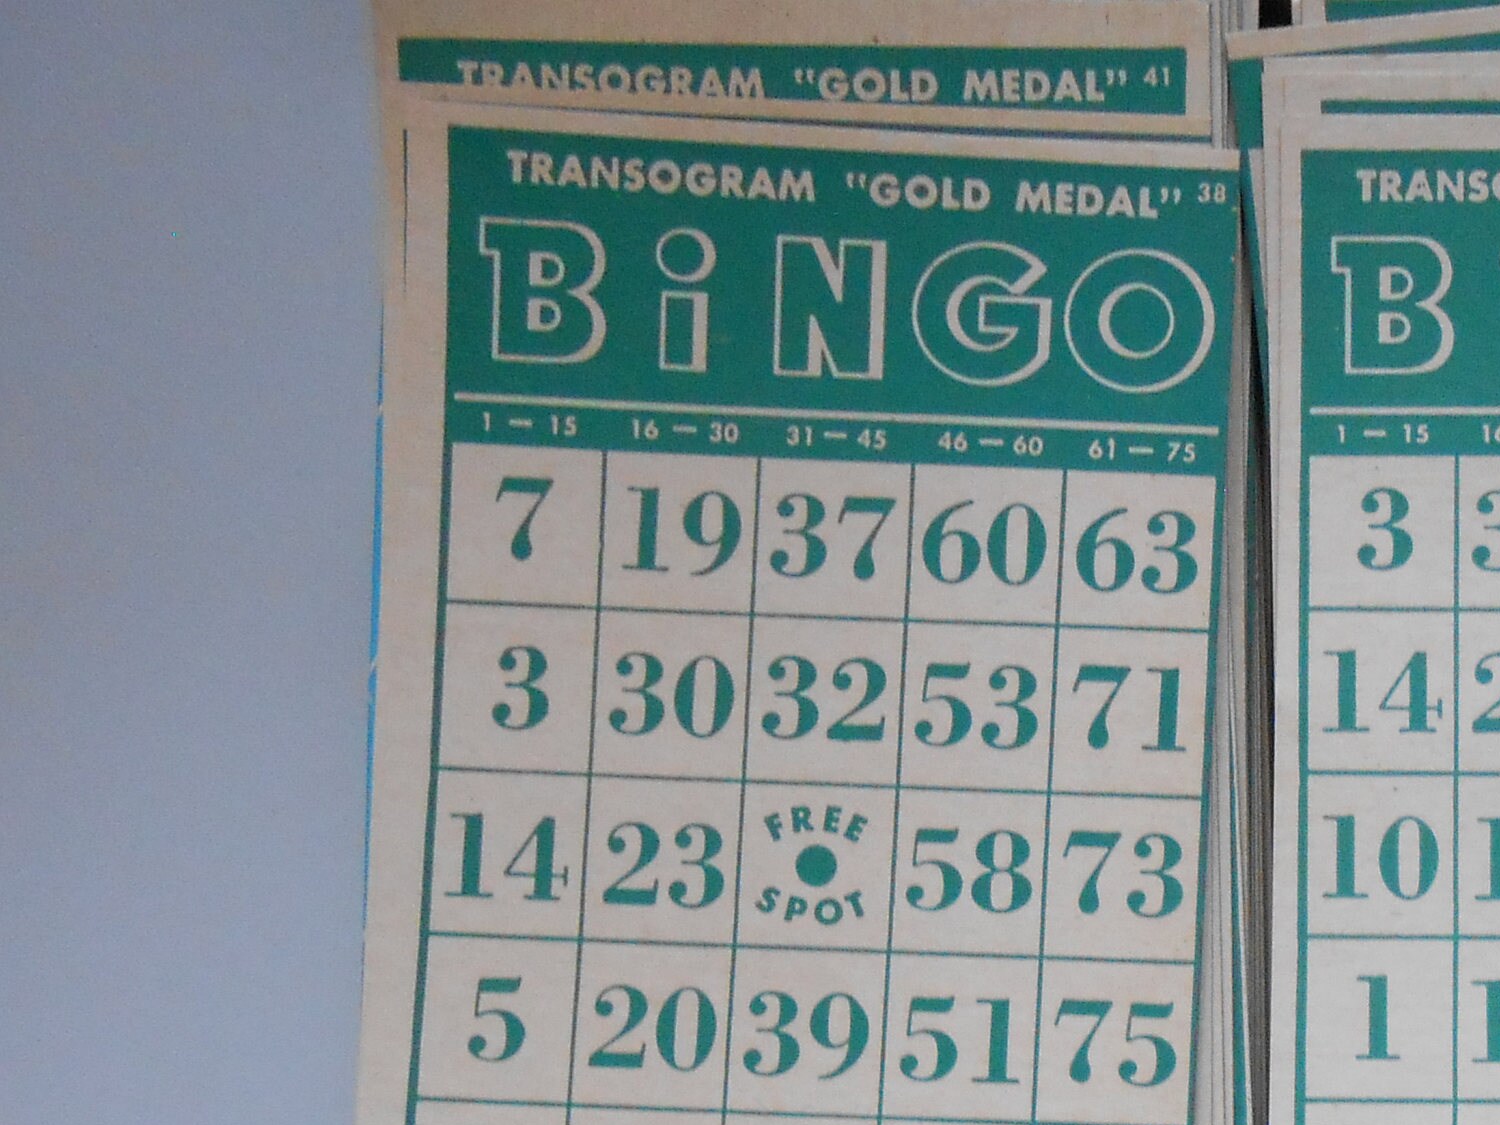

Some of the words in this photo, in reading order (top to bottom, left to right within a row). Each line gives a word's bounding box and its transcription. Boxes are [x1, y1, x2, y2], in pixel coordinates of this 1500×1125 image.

[453, 61, 767, 104] TRANSOGRAM
[1144, 67, 1169, 86] 41
[507, 150, 815, 201] TRANSOGRAM
[1198, 183, 1226, 203] 38
[497, 477, 553, 560] 7
[624, 487, 741, 575] 19
[770, 494, 896, 580] 37
[923, 501, 1046, 584] 60
[1076, 509, 1197, 594] 63
[1358, 488, 1413, 570] 3
[493, 647, 549, 729] 3
[609, 653, 734, 738] 30
[762, 656, 886, 742] 32
[915, 663, 1038, 749] 53
[1073, 665, 1185, 751] 71
[1324, 650, 1442, 732] 14
[764, 806, 868, 842] FREE
[1324, 815, 1439, 900] 10
[447, 814, 568, 901] 14
[603, 823, 724, 908] 23
[906, 829, 1032, 913] 58
[1064, 831, 1183, 917] 73
[756, 887, 864, 925] SPOT
[468, 978, 525, 1060] 5
[589, 985, 716, 1069] 20
[744, 992, 869, 1078] 39
[900, 997, 1018, 1083] 51
[1055, 1000, 1176, 1087] 75
[1357, 976, 1399, 1059] 1
